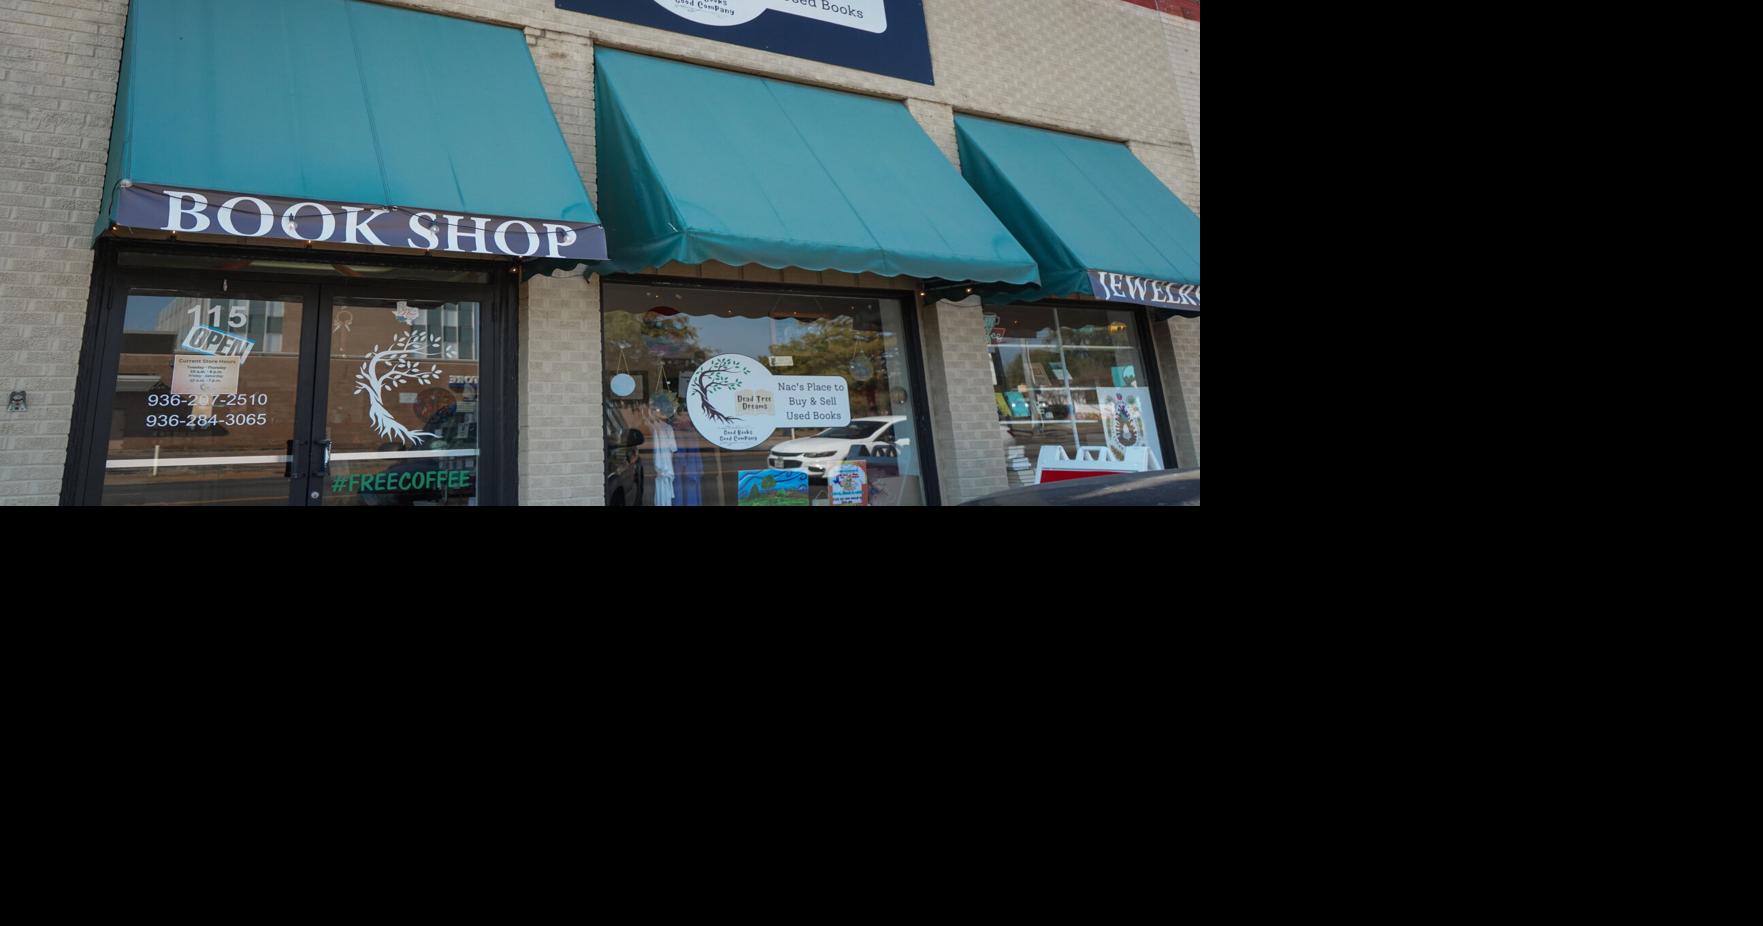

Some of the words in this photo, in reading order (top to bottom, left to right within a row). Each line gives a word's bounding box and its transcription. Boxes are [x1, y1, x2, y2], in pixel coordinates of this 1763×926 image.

[821, 0, 864, 19] Books
[160, 190, 391, 246] BOOK
[407, 211, 577, 259] SHOP
[187, 304, 248, 328] 115
[188, 326, 250, 357] OPEN
[777, 382, 805, 392] Nac's
[807, 382, 832, 392] Place
[834, 382, 845, 392] to
[737, 395, 754, 403] Dead
[755, 395, 772, 403] Tree
[742, 402, 768, 410] Dreams
[789, 397, 808, 408] Buy
[810, 397, 817, 406] &
[820, 397, 837, 406] Sell
[146, 413, 267, 428] 936-284-3065
[786, 411, 810, 420] Used
[812, 411, 842, 420] Books
[331, 470, 472, 493] #FREECOFFEE
